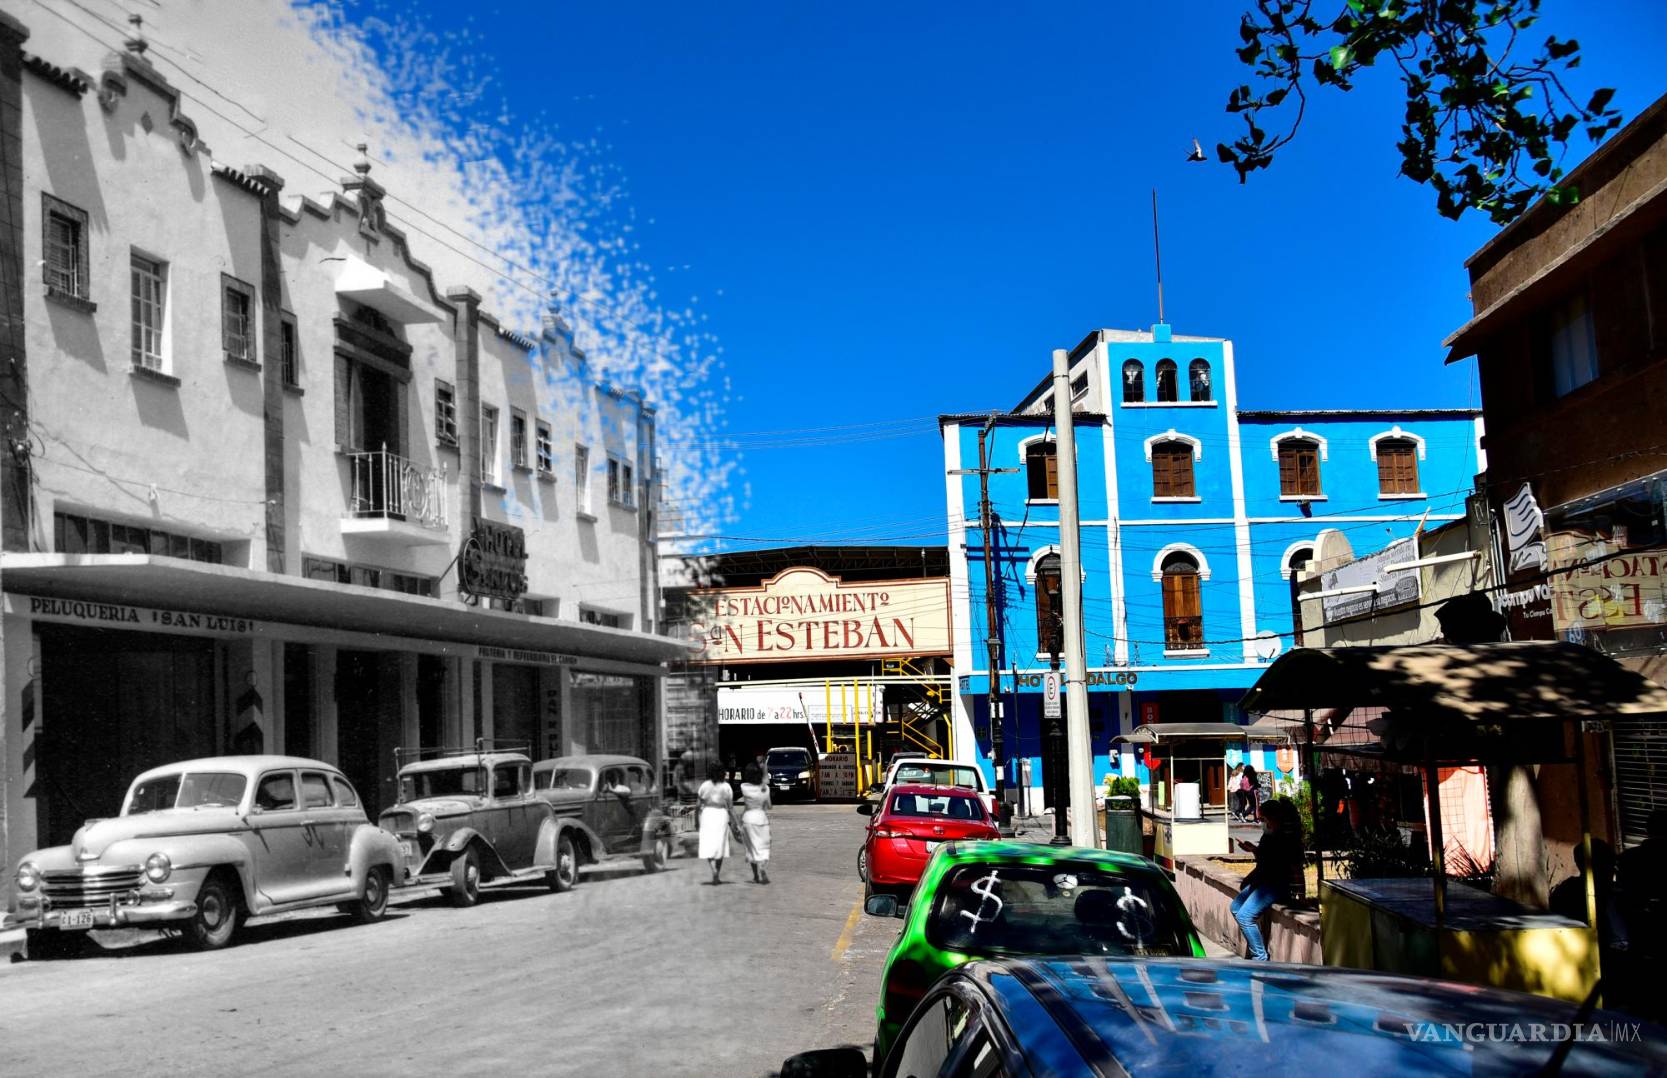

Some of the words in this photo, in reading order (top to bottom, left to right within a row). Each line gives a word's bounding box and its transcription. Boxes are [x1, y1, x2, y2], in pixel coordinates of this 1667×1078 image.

[30, 597, 139, 622] PELUQUERIA
[757, 616, 915, 651] ESTEBAN
[1087, 671, 1138, 686] DALGO
[718, 707, 755, 720] HORARIO
[757, 709, 766, 720] de
[767, 707, 773, 719] 7
[774, 711, 779, 720] a
[780, 707, 792, 719] 22
